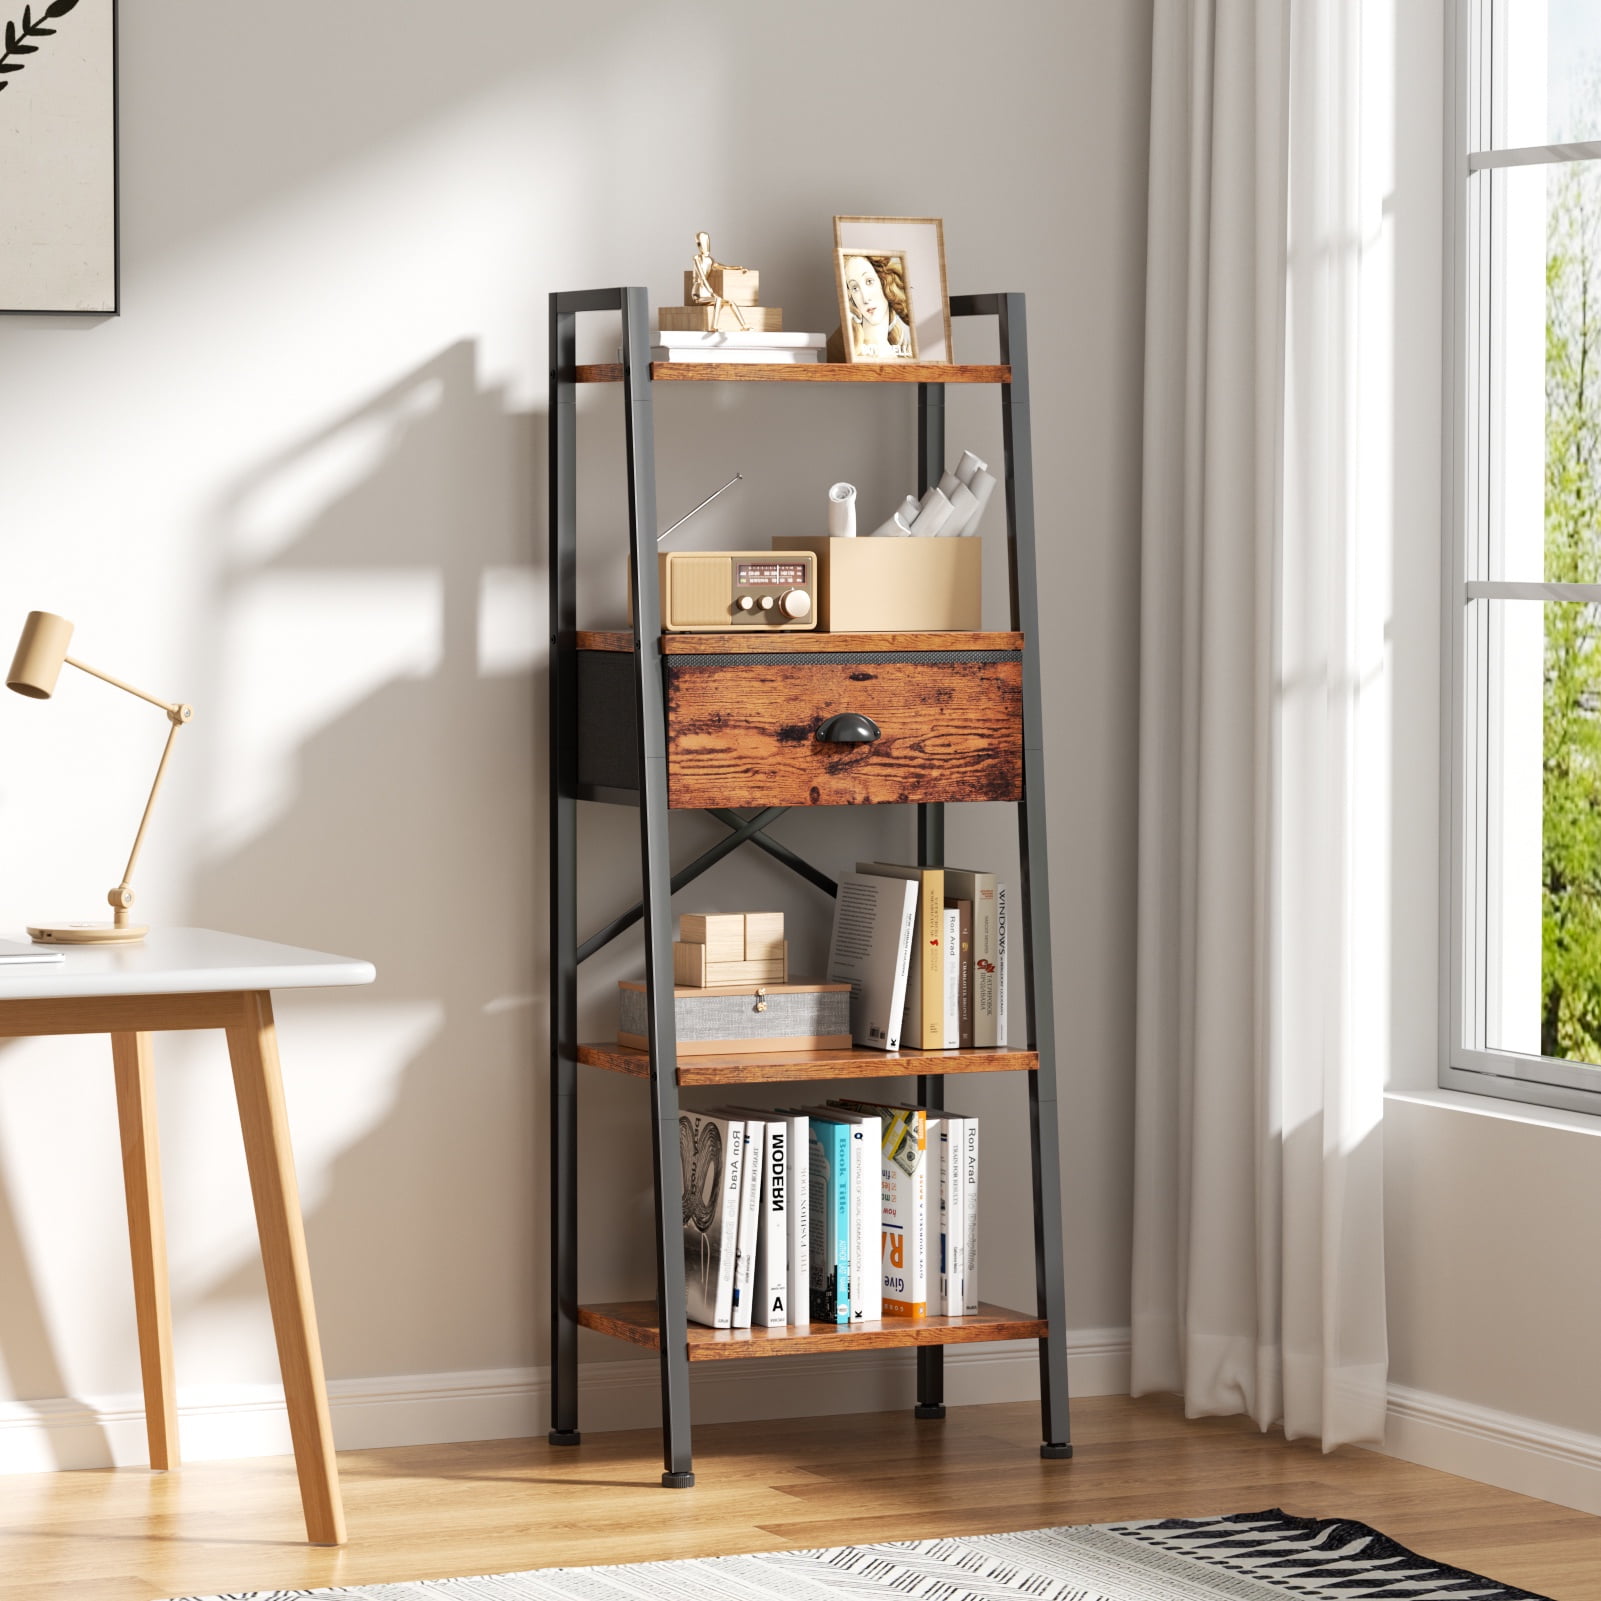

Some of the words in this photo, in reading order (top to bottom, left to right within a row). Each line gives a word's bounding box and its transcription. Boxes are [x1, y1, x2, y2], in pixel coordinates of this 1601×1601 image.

[968, 1128, 976, 1152] Ron
[882, 1169, 890, 1180] fin
[968, 1156, 976, 1184] Arad
[882, 1181, 890, 1192] les
[883, 1208, 897, 1218] how
[884, 1276, 904, 1293] Give
